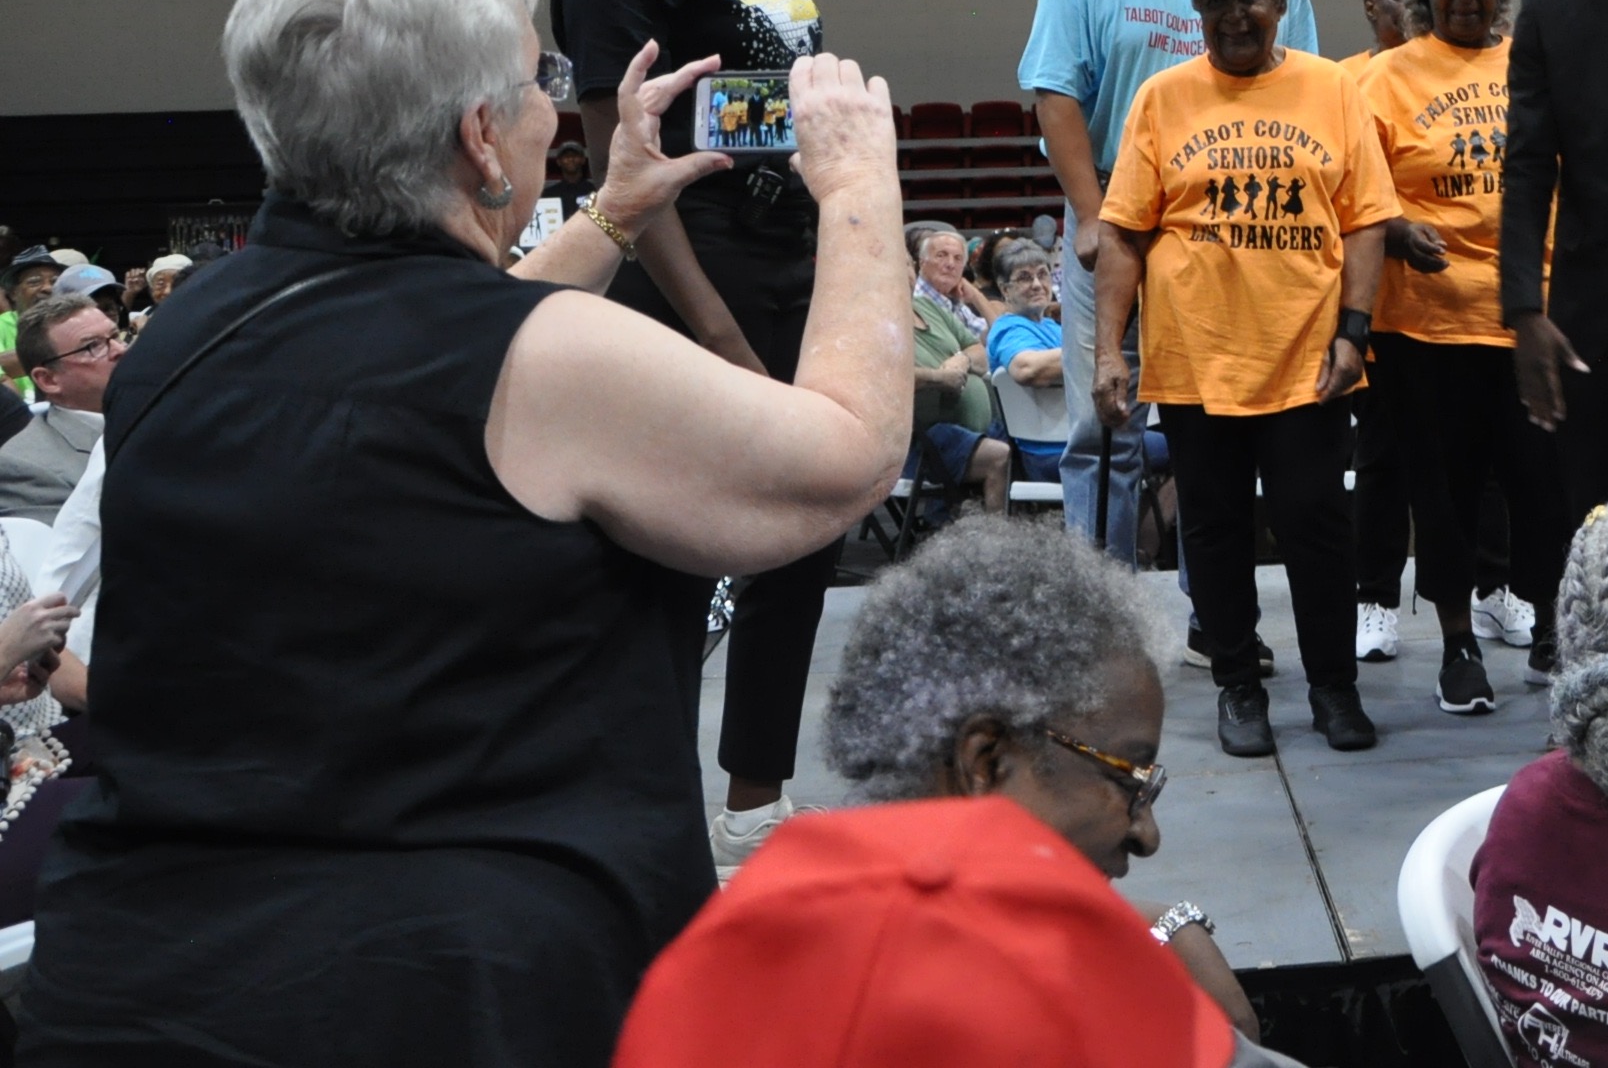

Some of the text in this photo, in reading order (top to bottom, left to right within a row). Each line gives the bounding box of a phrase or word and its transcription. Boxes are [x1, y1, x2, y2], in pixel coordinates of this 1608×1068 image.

[1124, 6, 1201, 34] TALBOT COUNTY
[1414, 82, 1480, 131] TALBOT
[1170, 119, 1333, 172] TALBOT COUNTY
[1207, 145, 1295, 171] SENIORS
[1431, 172, 1475, 199] LINE
[1229, 223, 1325, 251] DANCERS
[1530, 947, 1551, 964] AREA
[1551, 958, 1586, 980] AGENCY
[1585, 972, 1600, 987] ON
[1565, 952, 1601, 977] REGIONAL
[1539, 977, 1553, 998] TO
[1550, 987, 1573, 1010] OUR
